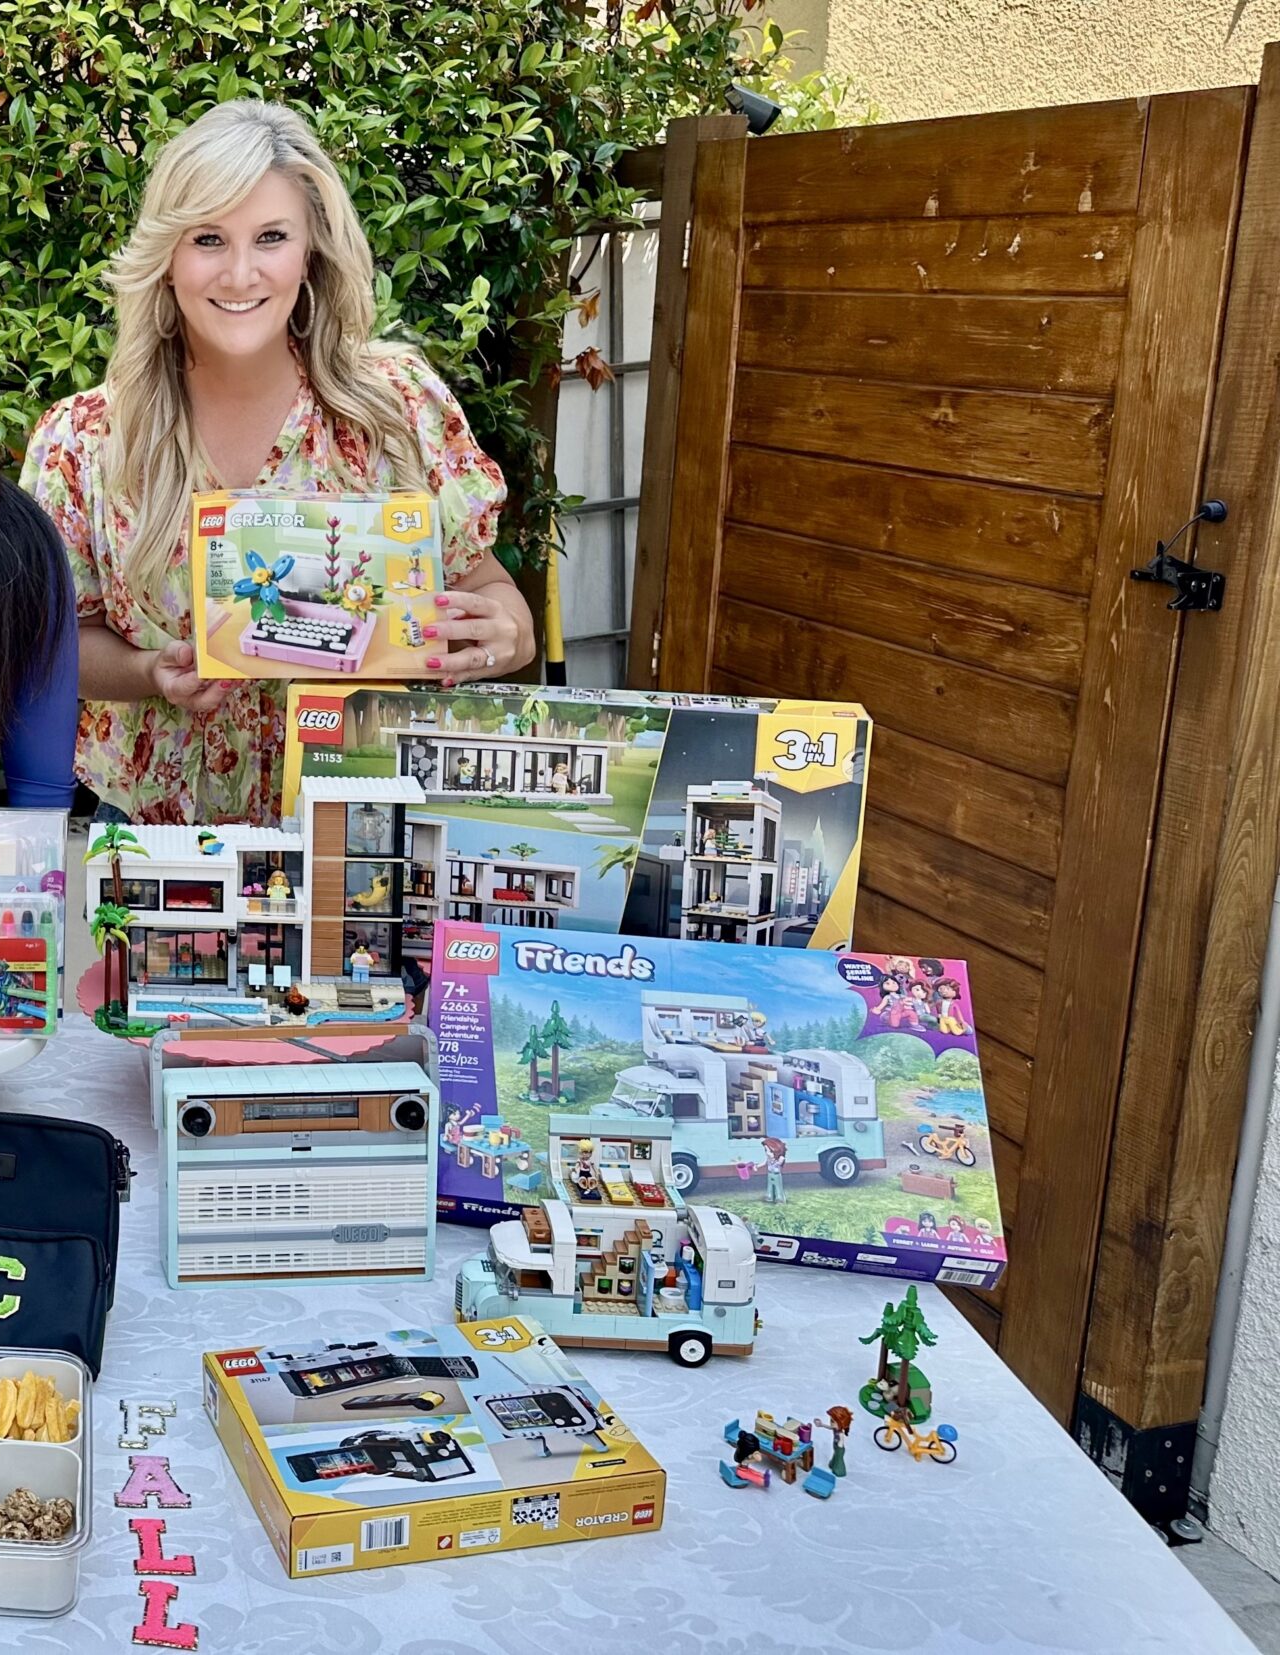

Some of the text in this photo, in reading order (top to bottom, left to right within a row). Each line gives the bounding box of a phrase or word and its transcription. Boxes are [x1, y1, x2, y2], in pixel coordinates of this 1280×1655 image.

[201, 513, 305, 528] LEGO CREATOR
[210, 541, 223, 551] 8+
[298, 710, 341, 729] LEGO
[313, 752, 343, 763] 31153
[446, 940, 656, 982] LEGO Friends
[441, 981, 469, 999] 7+
[440, 1001, 478, 1013] 42663
[440, 1014, 480, 1024] Friendship
[440, 1023, 486, 1032] Camper Van
[439, 1031, 480, 1040] Adventure
[438, 1040, 459, 1052] 778
[438, 1053, 479, 1066] pcs/pzs
[462, 1202, 520, 1216] Friends
[344, 1226, 377, 1241] LEGO
[224, 1358, 258, 1369] LEGO
[575, 1508, 654, 1527] LEGO CREATOR
